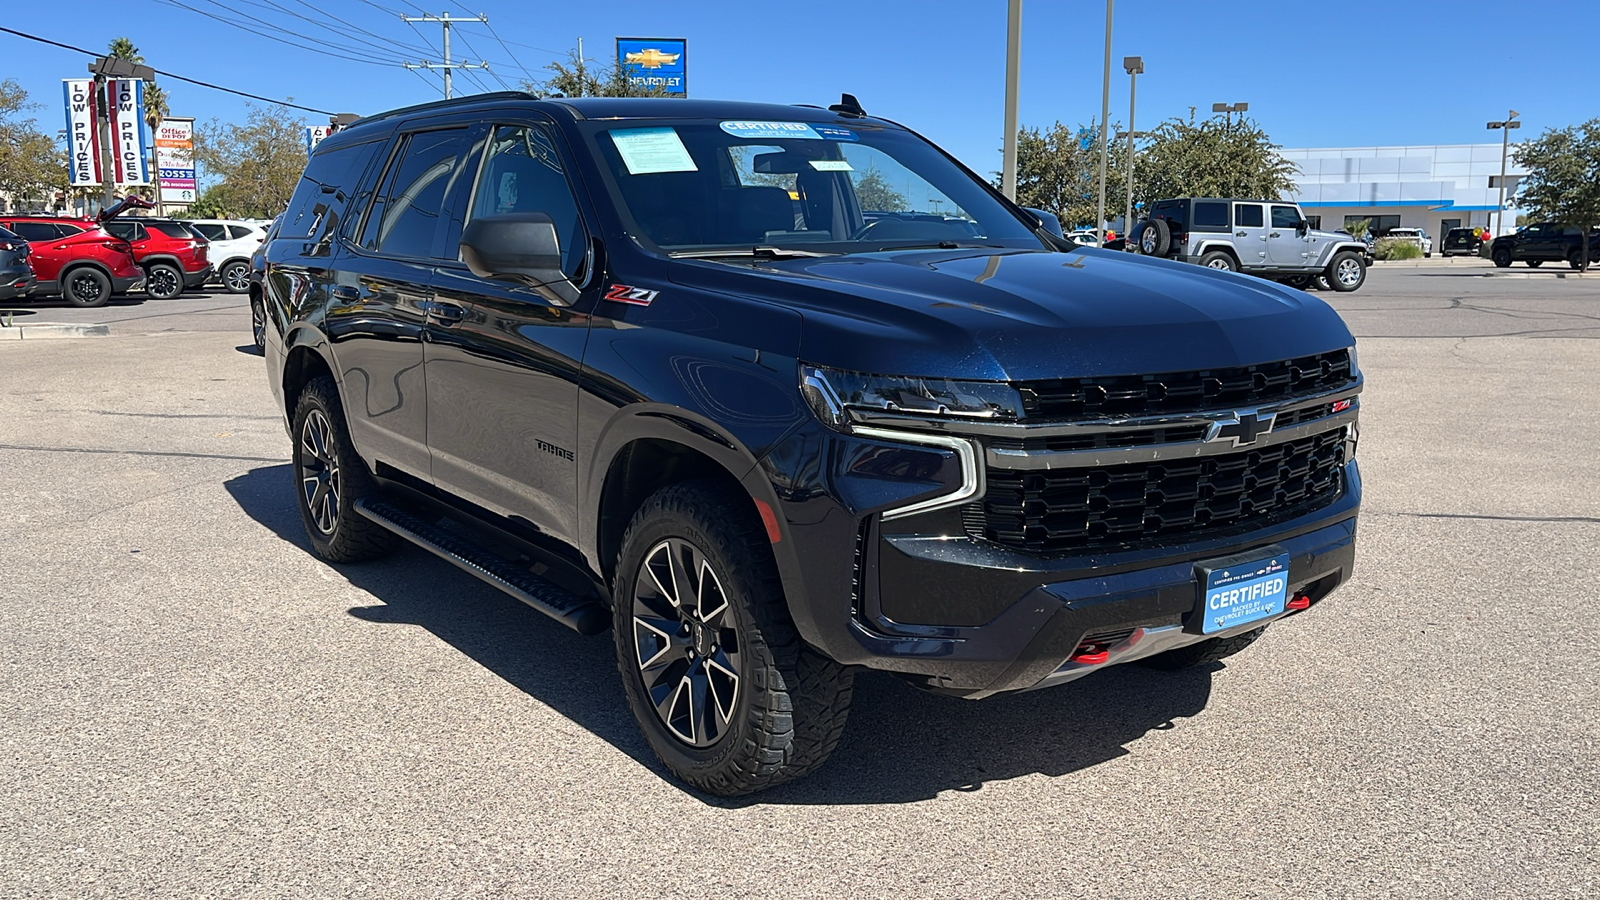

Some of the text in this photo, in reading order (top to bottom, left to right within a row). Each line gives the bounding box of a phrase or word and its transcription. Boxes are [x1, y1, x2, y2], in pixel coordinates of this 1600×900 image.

[627, 76, 681, 86] HEVROLET
[723, 122, 808, 131] CERTIFIED
[73, 84, 90, 181] LOW PRICES
[119, 83, 138, 181] LOW PRICES
[160, 170, 185, 178] ROSS
[1210, 578, 1283, 610] CERTIFIED
[1232, 603, 1253, 612] BACKED
